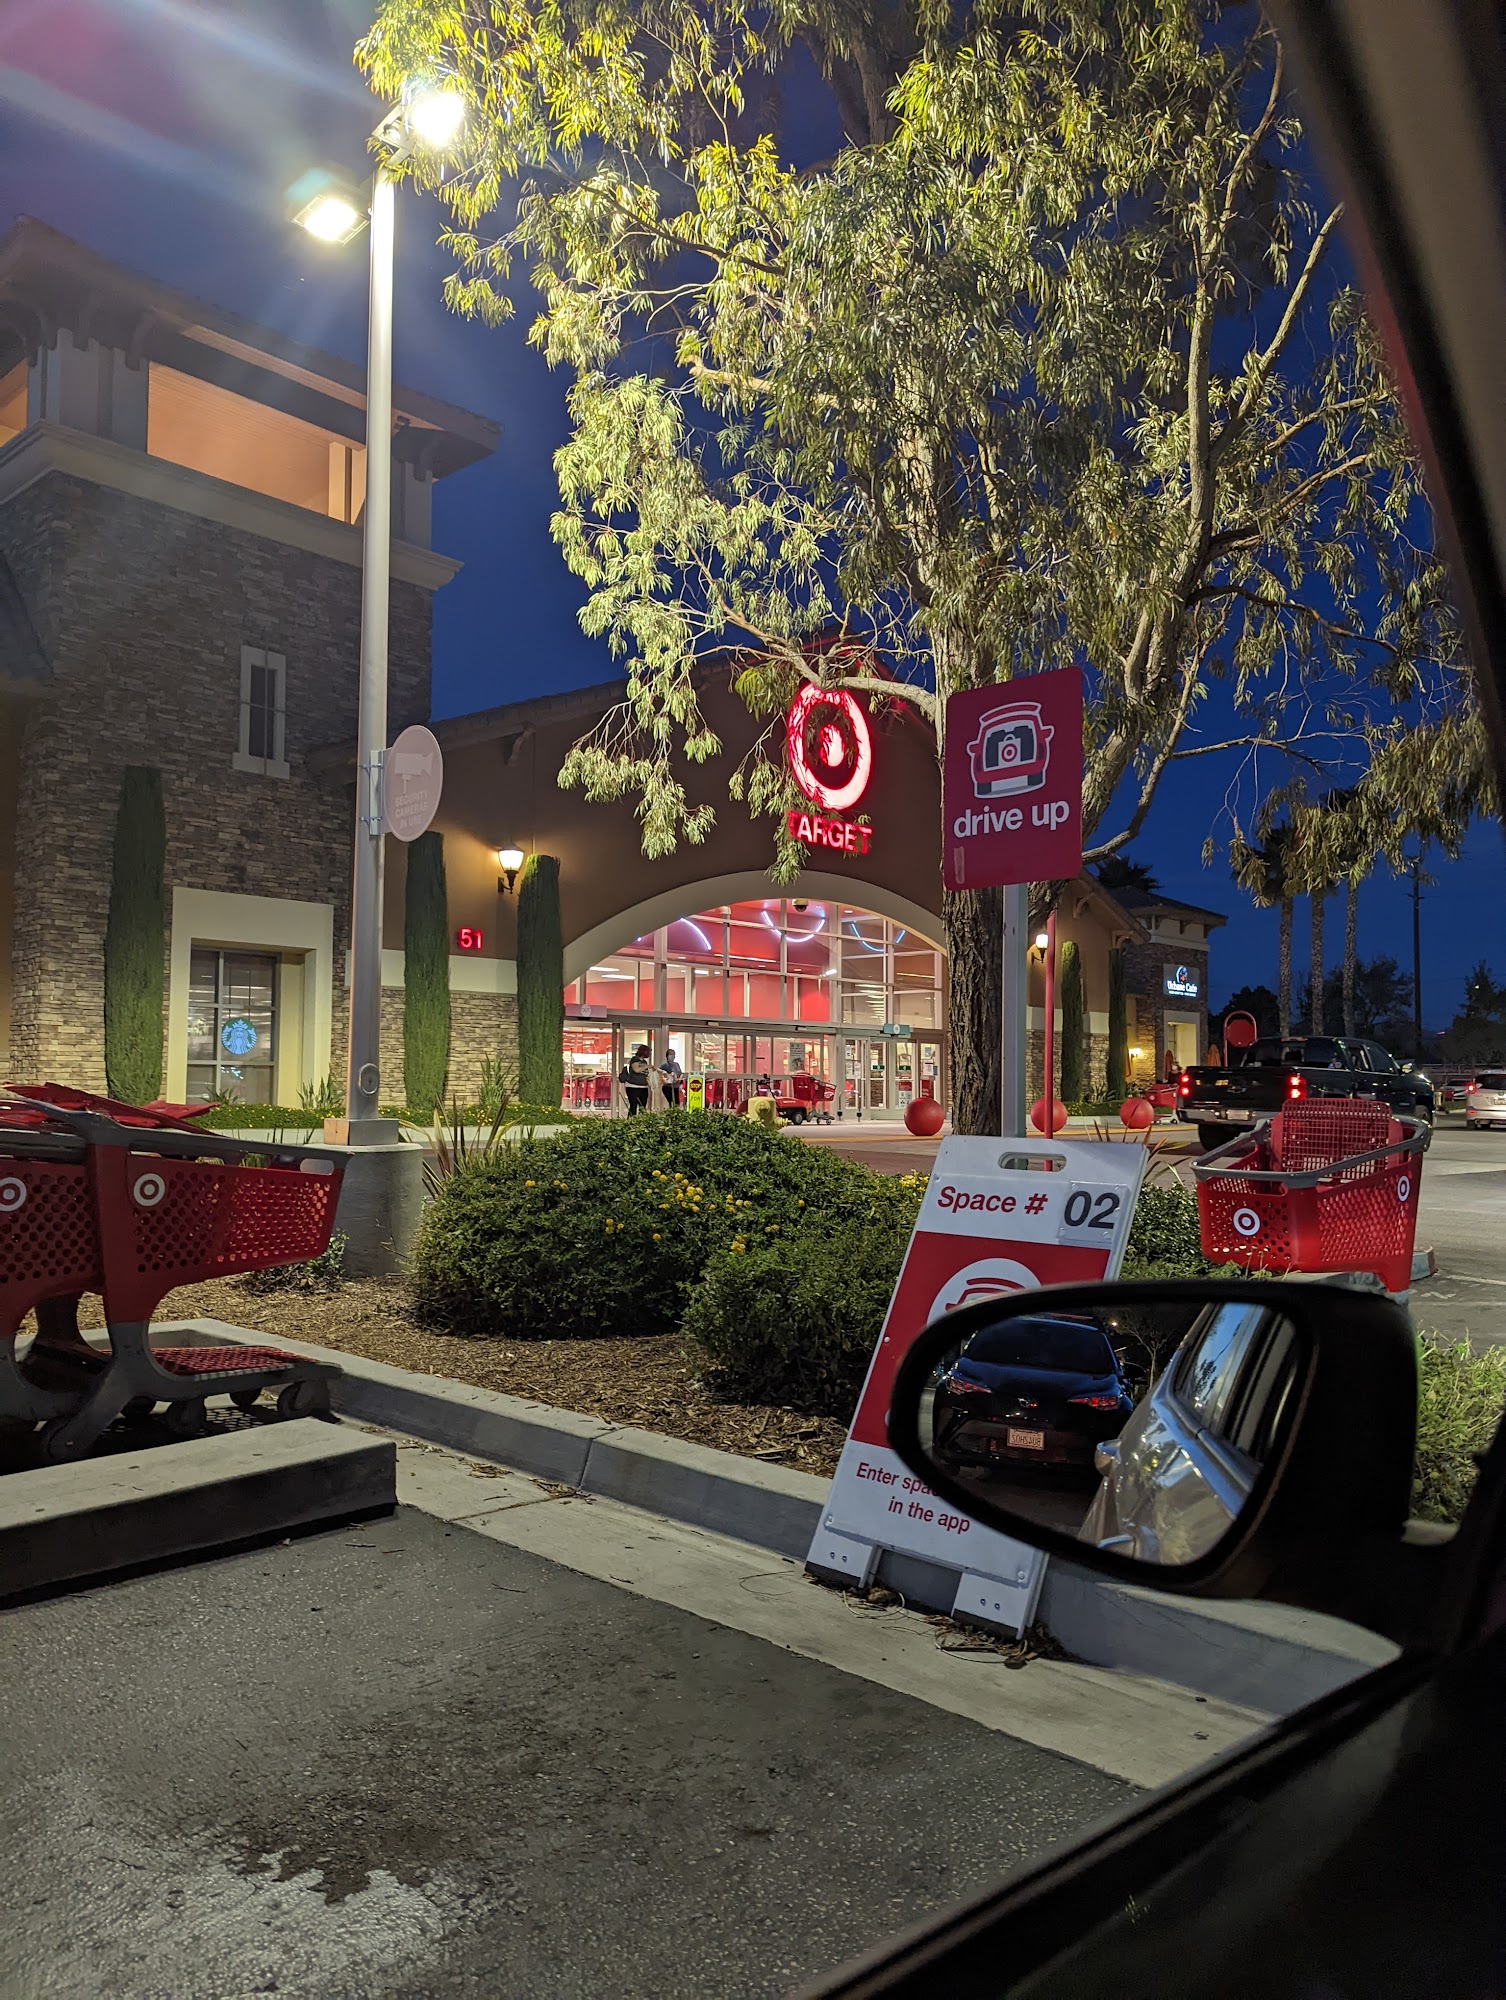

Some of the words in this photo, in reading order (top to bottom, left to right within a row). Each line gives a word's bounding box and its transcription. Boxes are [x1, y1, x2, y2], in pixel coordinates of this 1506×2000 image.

[787, 810, 873, 854] TARGET
[953, 805, 1024, 838] drive
[1031, 800, 1070, 831] up
[459, 927, 482, 949] 51
[937, 1185, 1017, 1214] Space
[1024, 1192, 1049, 1215] #
[1063, 1190, 1121, 1229] 02
[856, 1461, 900, 1486] Enter
[901, 1476, 939, 1497] spa
[888, 1495, 904, 1515] in
[907, 1501, 934, 1522] the
[937, 1513, 971, 1535] app
